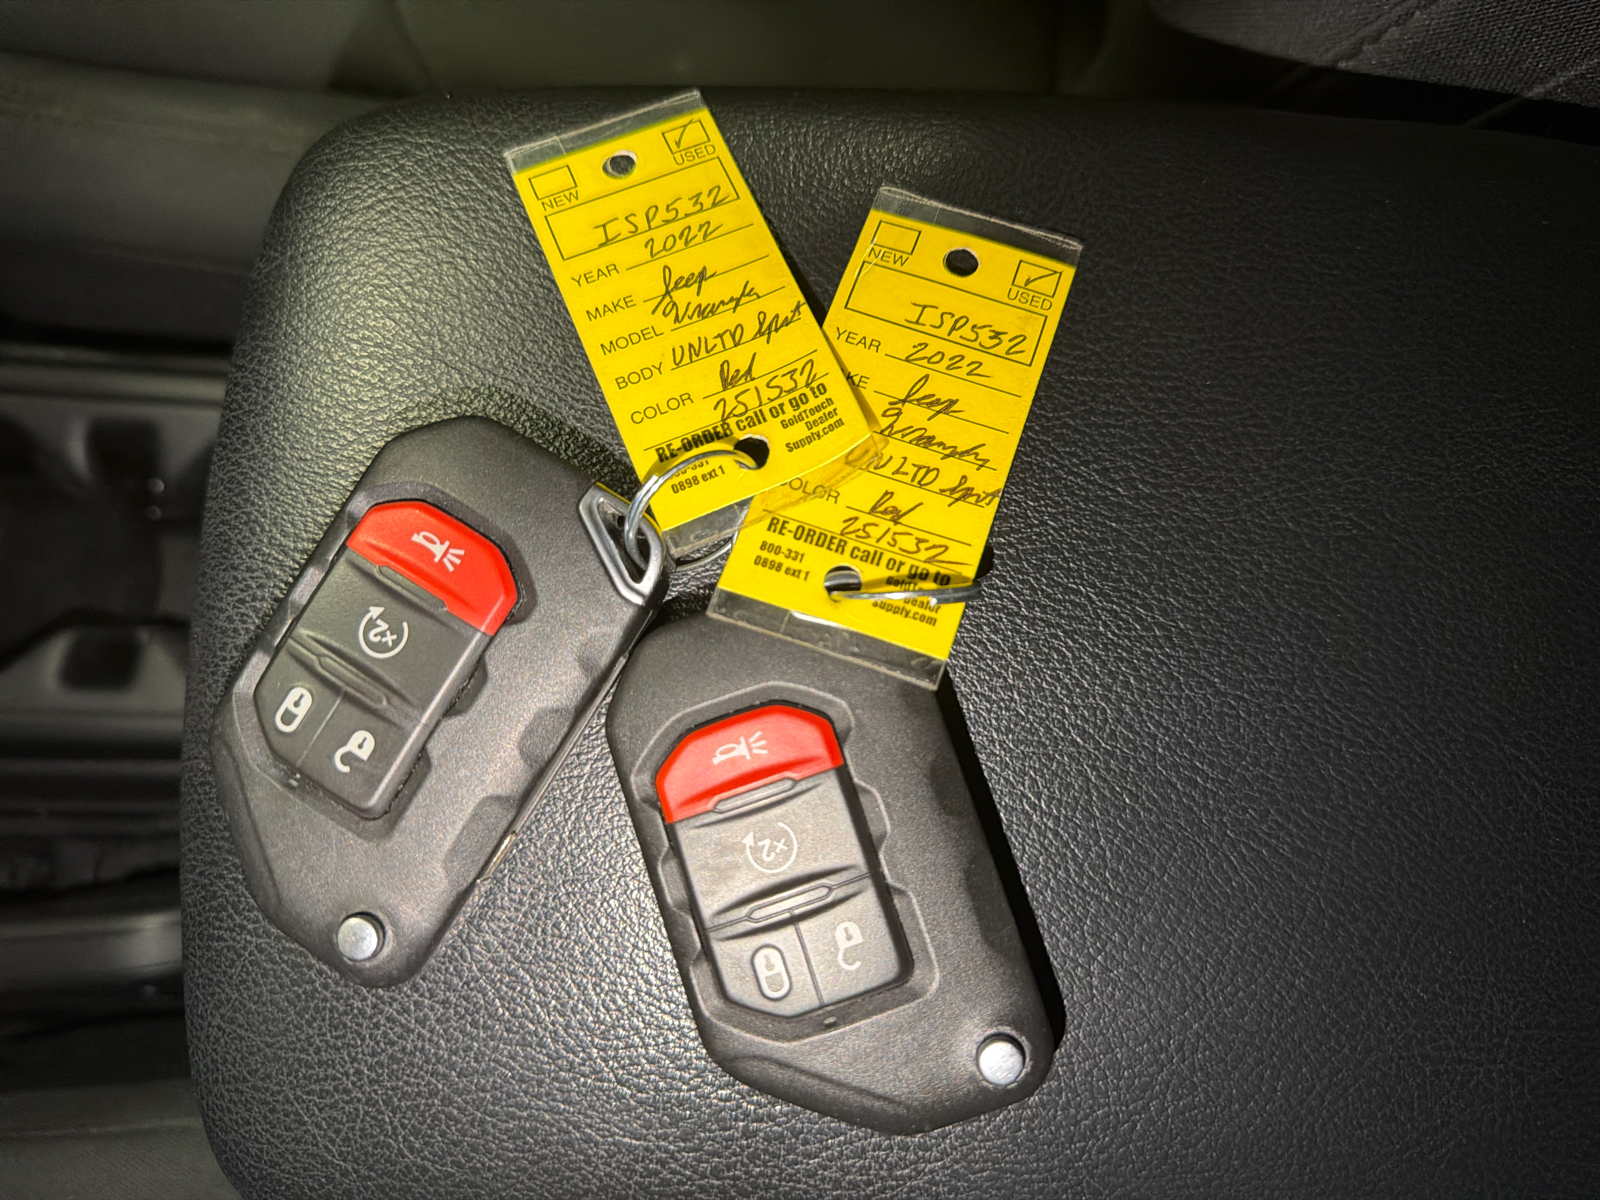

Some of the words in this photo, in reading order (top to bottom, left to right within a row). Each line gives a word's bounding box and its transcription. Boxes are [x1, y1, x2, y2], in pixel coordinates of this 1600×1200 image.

[672, 144, 717, 167] USED
[541, 190, 579, 212] NEW
[594, 185, 732, 246] ISP532
[644, 220, 723, 258] 2022
[867, 247, 910, 267] NEW
[571, 263, 620, 288] YEAR
[586, 295, 637, 321] MAKE
[1006, 286, 1053, 312] USED
[600, 325, 664, 355] MODEL
[834, 326, 882, 353] YEAR
[904, 301, 1028, 357] ISP532
[672, 323, 744, 367] UNLTD
[904, 342, 991, 378] 2022
[614, 361, 663, 390] BODY
[841, 368, 870, 389] KE
[713, 359, 819, 422] 251532
[630, 392, 694, 425] COLOR
[654, 421, 734, 463] RE-ORDER
[735, 408, 768, 431] call
[769, 402, 786, 419] or
[788, 392, 809, 411] go
[809, 383, 827, 399] to
[780, 397, 834, 429] GoldTouch
[804, 407, 838, 431] Dealer
[785, 417, 845, 453] Supply.com
[671, 475, 700, 494] 0898
[701, 468, 719, 482] ext
[718, 465, 726, 475] 1
[780, 477, 840, 504] OLOR
[759, 540, 805, 563] 800-331
[766, 516, 848, 555] RE-ORDER
[850, 546, 884, 567] call
[886, 557, 906, 573] or
[907, 564, 930, 580] go
[933, 571, 951, 586] to
[841, 516, 975, 566] 251532
[753, 555, 783, 573] 0898
[784, 566, 802, 579] ext
[803, 571, 810, 581] 1
